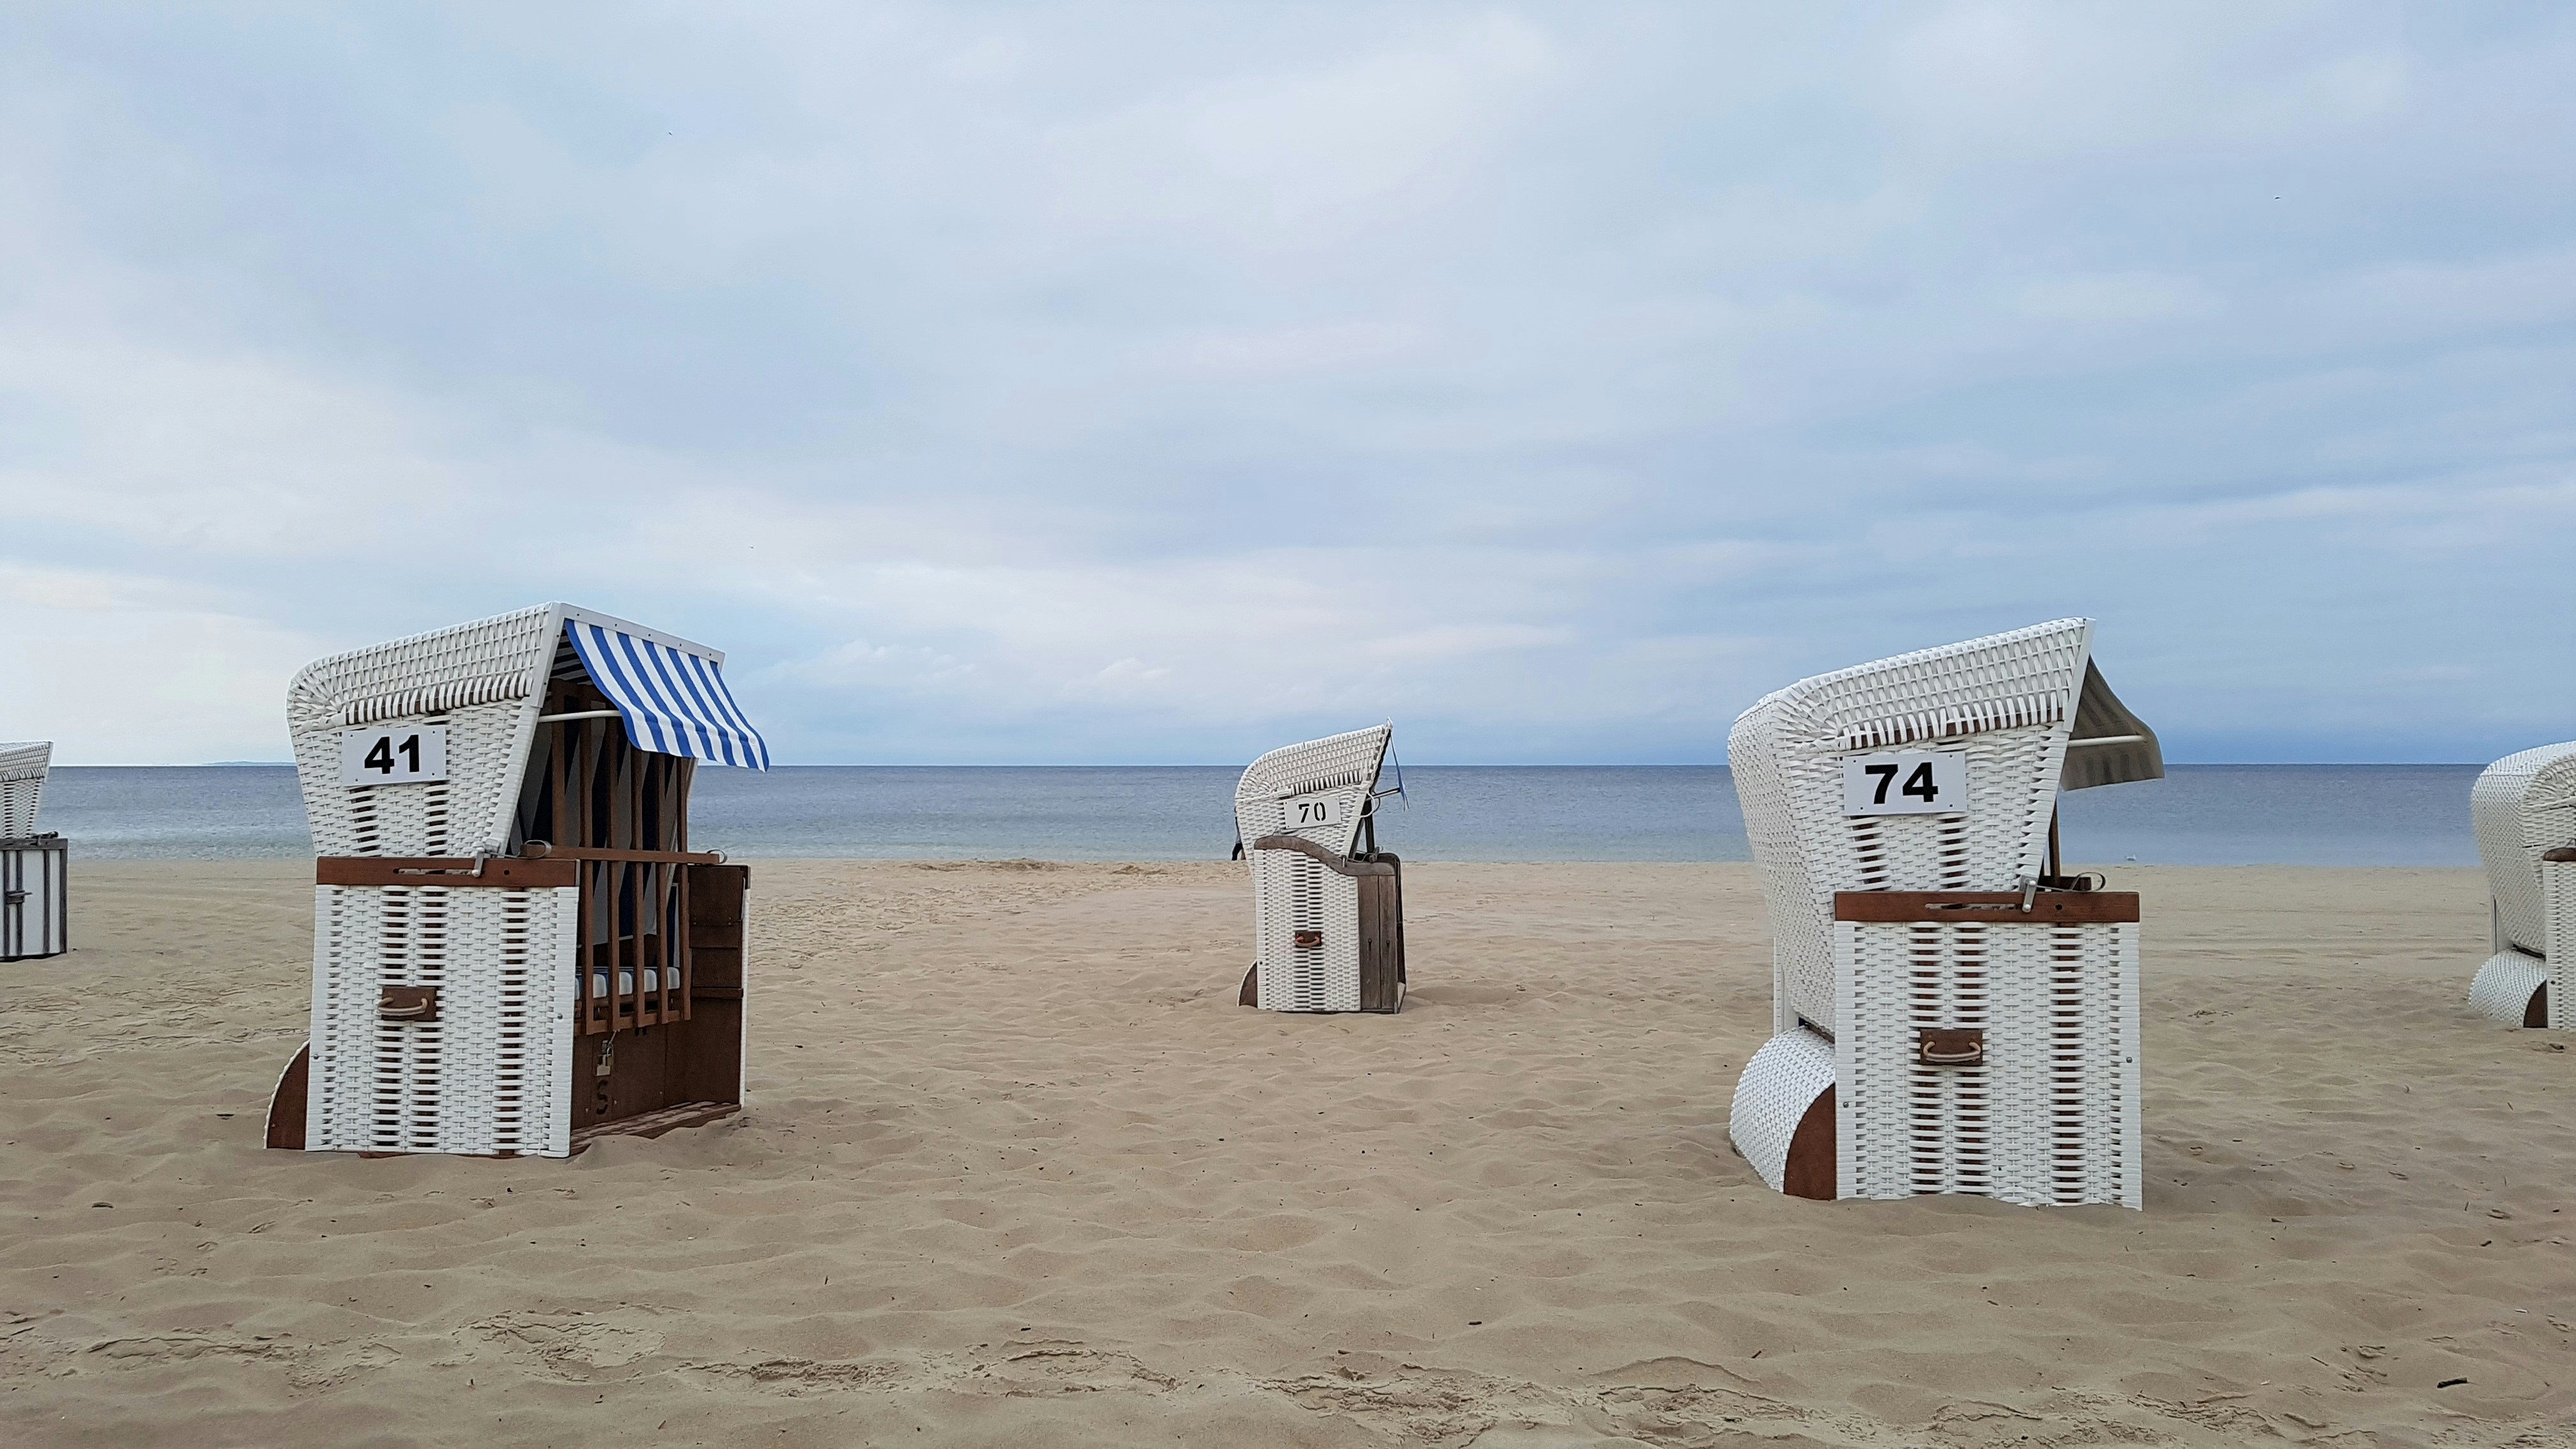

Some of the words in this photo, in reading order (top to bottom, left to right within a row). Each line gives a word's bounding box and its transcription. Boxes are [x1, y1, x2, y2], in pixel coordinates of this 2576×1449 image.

[364, 734, 420, 774] 41
[1864, 762, 1939, 805] 74
[1298, 802, 1326, 824] 70
